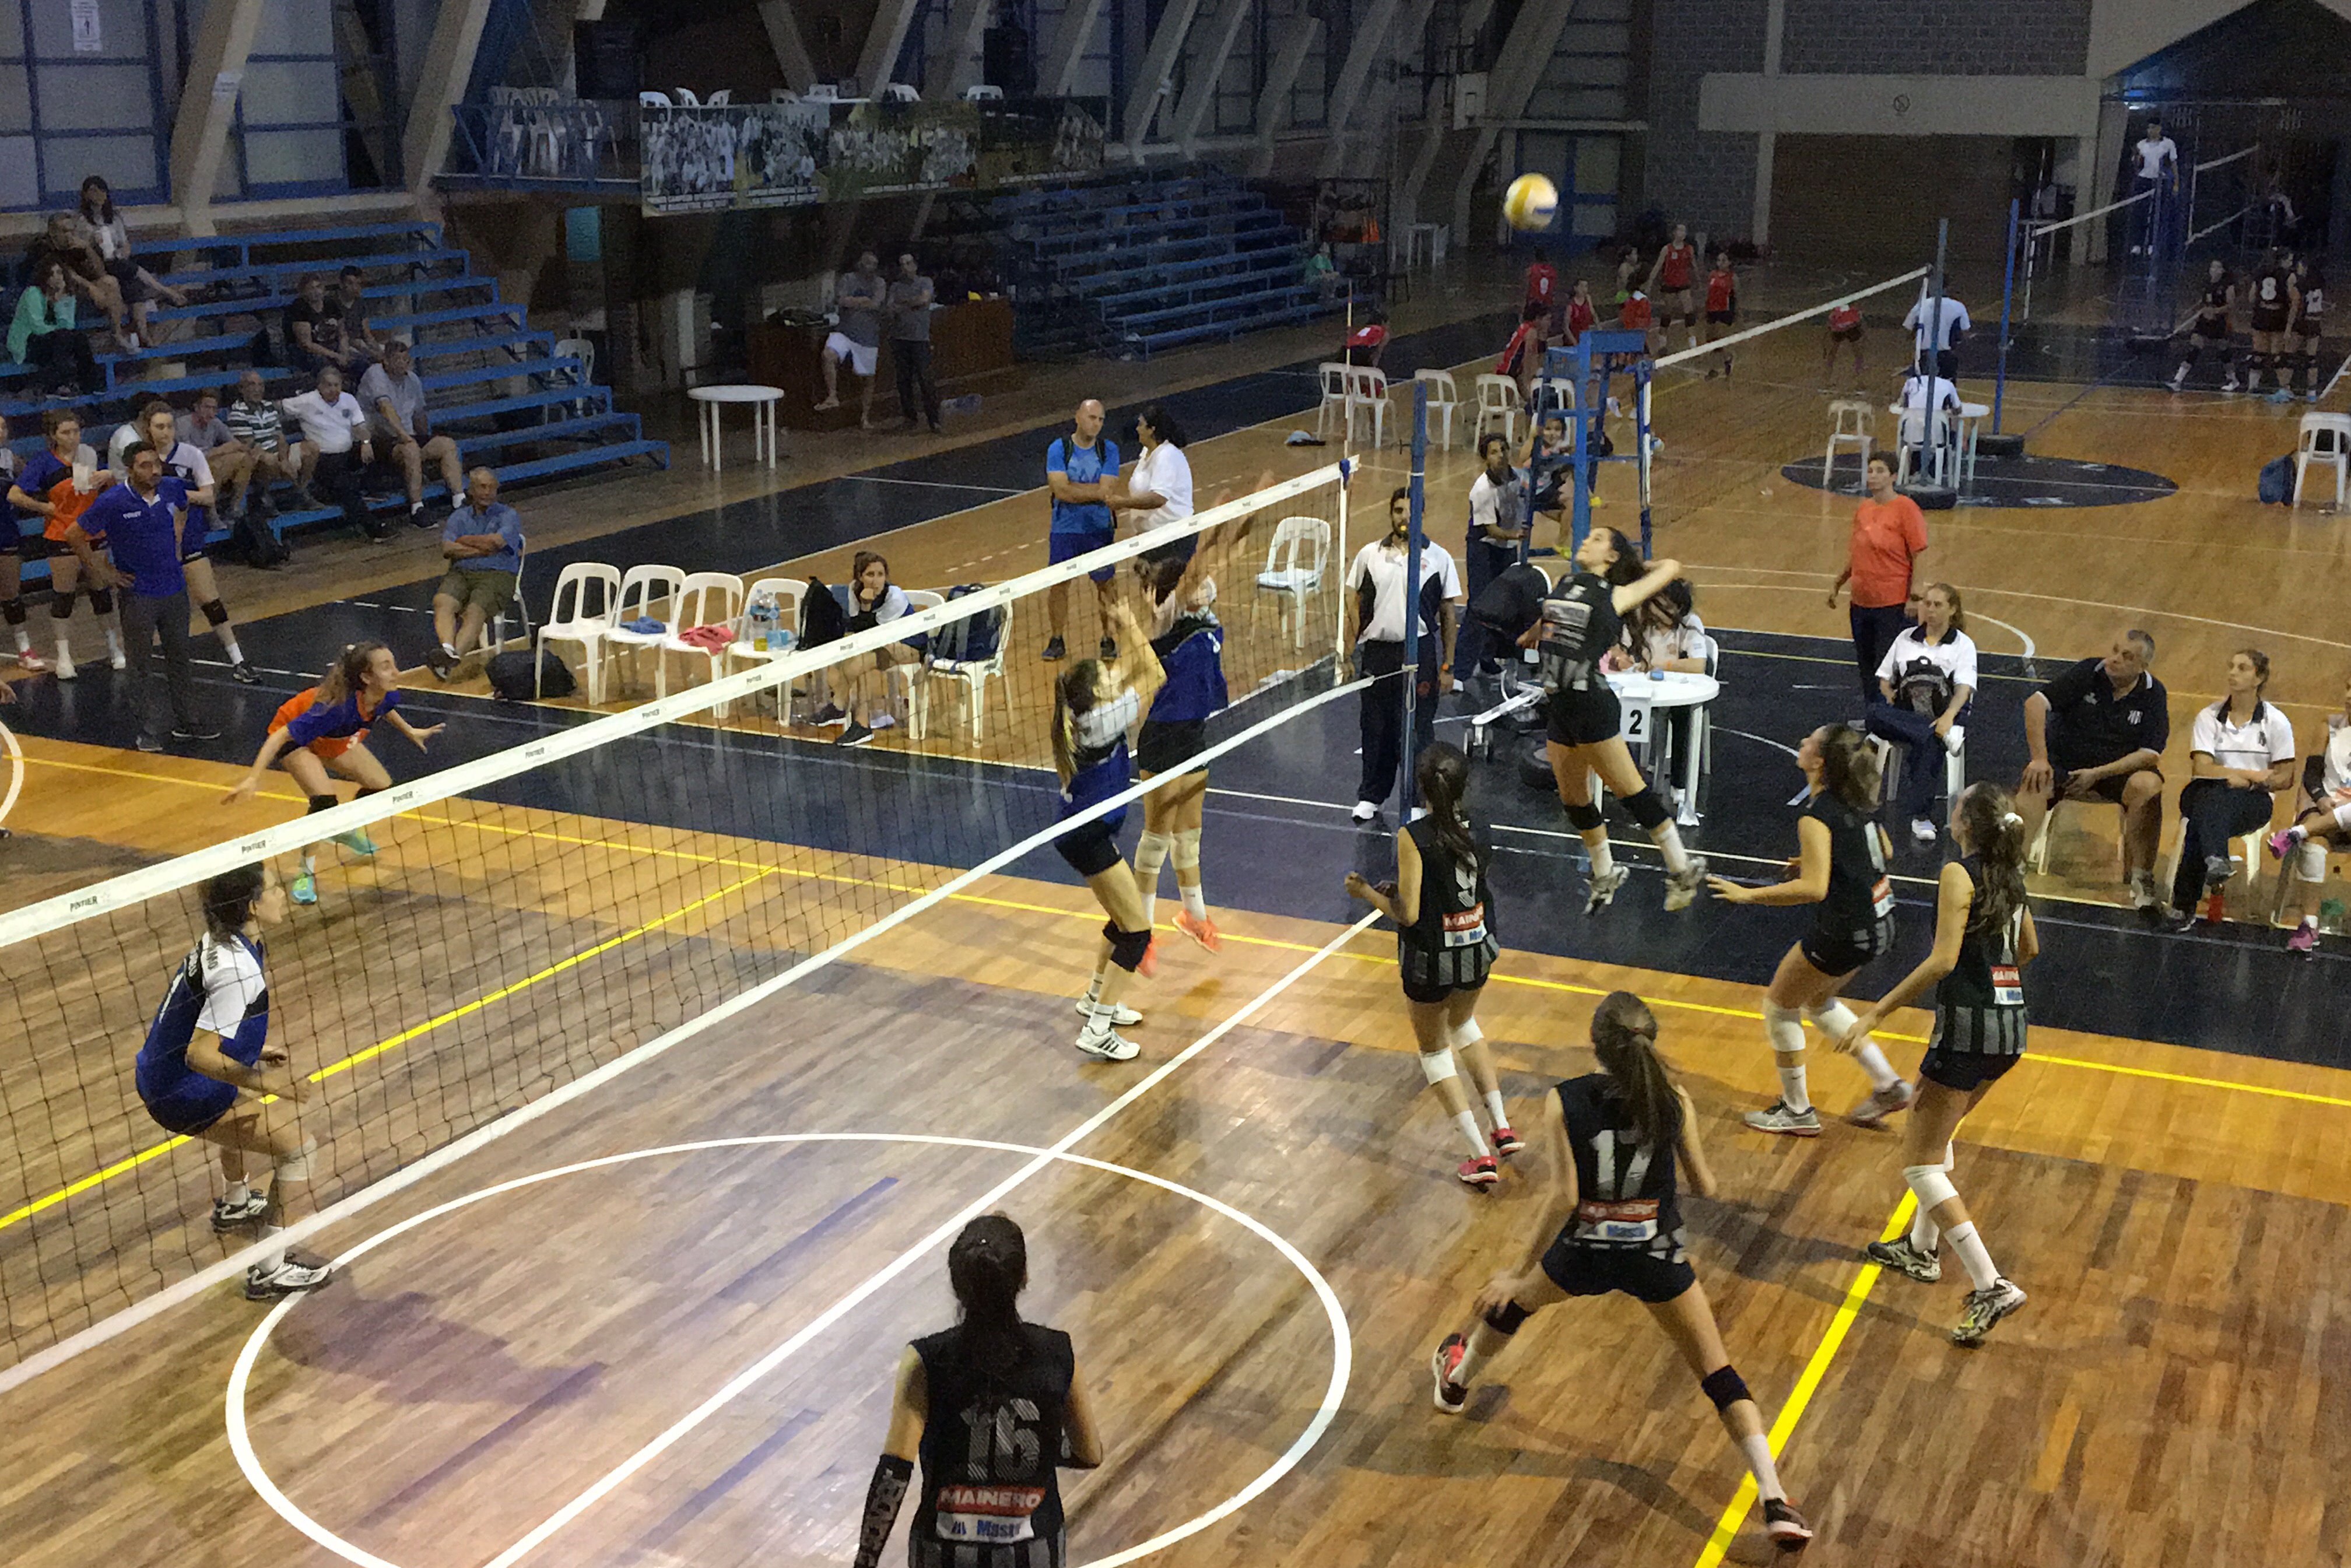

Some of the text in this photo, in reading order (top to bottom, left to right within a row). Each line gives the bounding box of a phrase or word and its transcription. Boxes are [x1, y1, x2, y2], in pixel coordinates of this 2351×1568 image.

[2260, 277, 2276, 300] 8
[1629, 709, 1643, 734] 2
[1588, 1129, 1654, 1199] 17
[960, 1398, 1040, 1482] 16
[940, 1489, 1041, 1508] MAINERO
